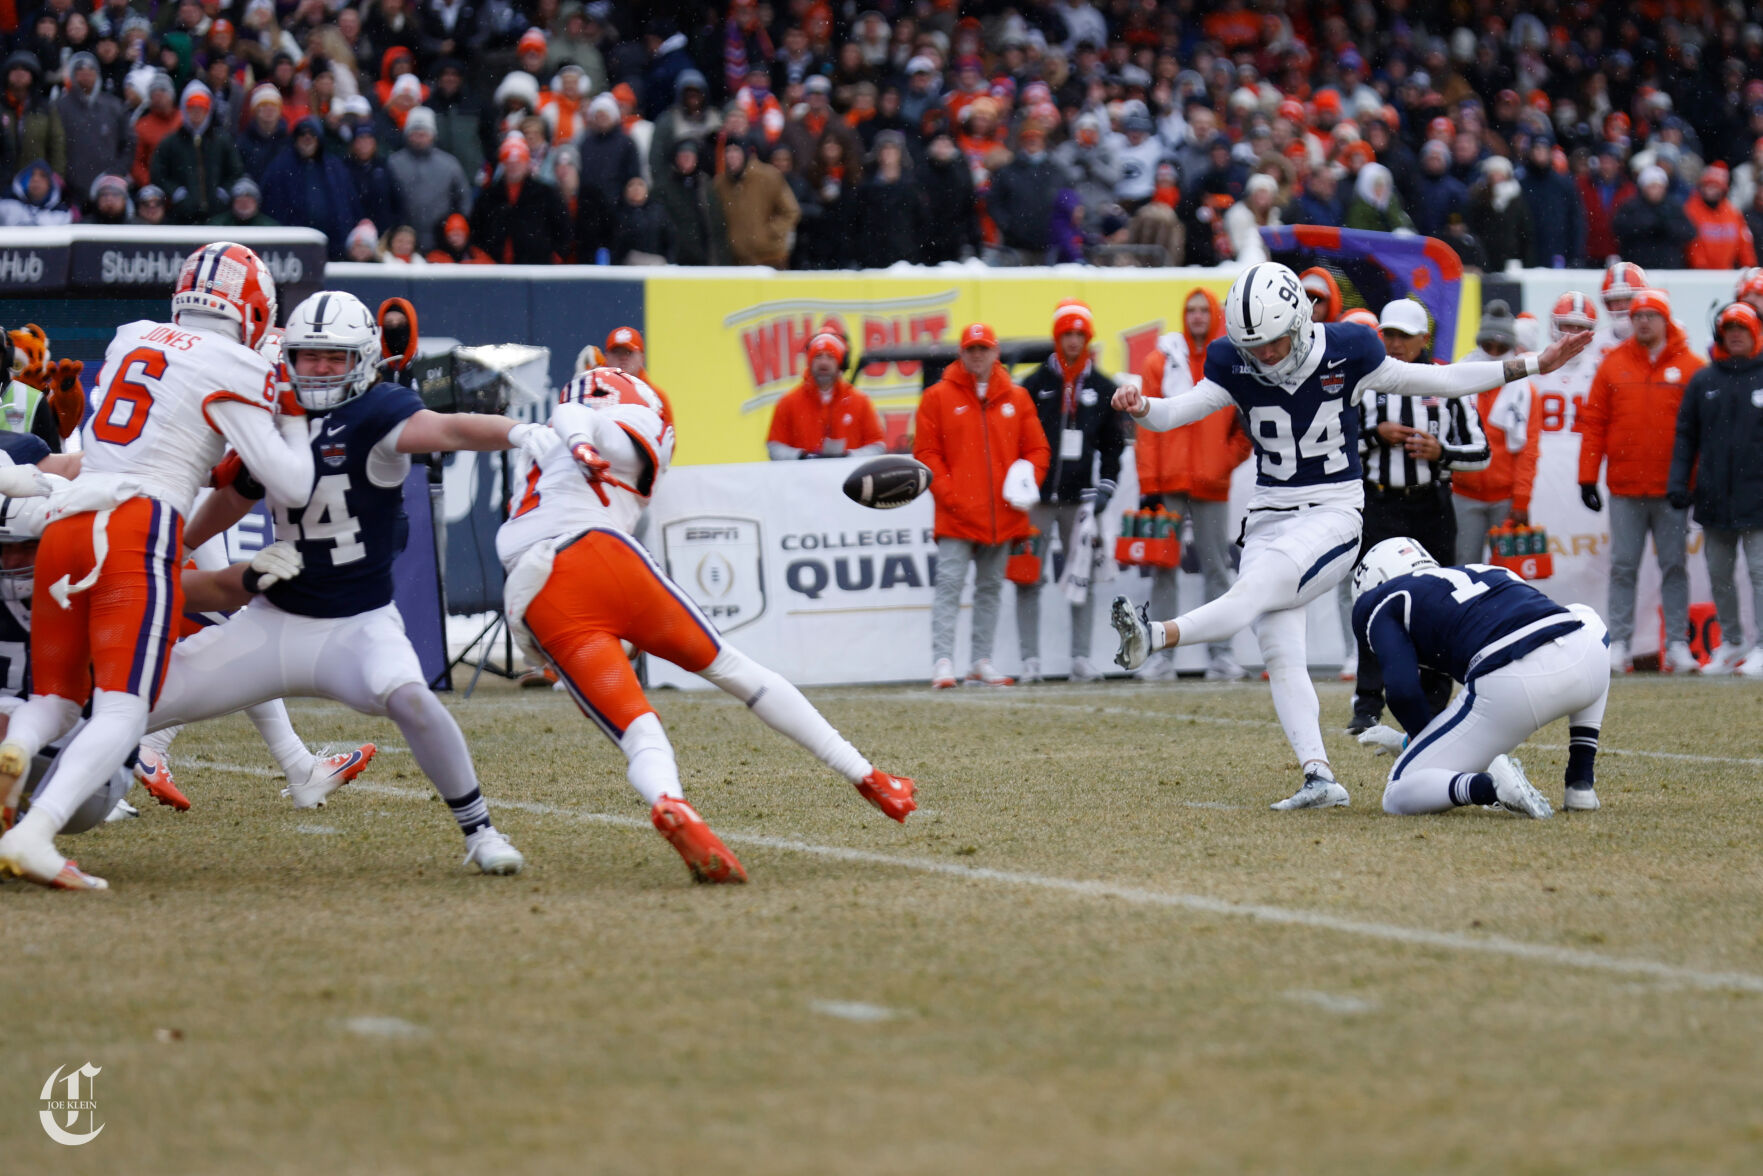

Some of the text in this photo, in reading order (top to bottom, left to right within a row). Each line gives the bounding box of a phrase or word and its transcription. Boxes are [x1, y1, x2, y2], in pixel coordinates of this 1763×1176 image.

[0, 251, 44, 283] Hub
[102, 251, 185, 283] StubHub
[262, 251, 303, 283] Hub
[1279, 274, 1299, 310] 94
[140, 326, 202, 352] JONES
[91, 346, 169, 447] 6
[1248, 397, 1350, 482] 94
[780, 529, 912, 552] COLLEGE
[785, 554, 940, 600] QUA
